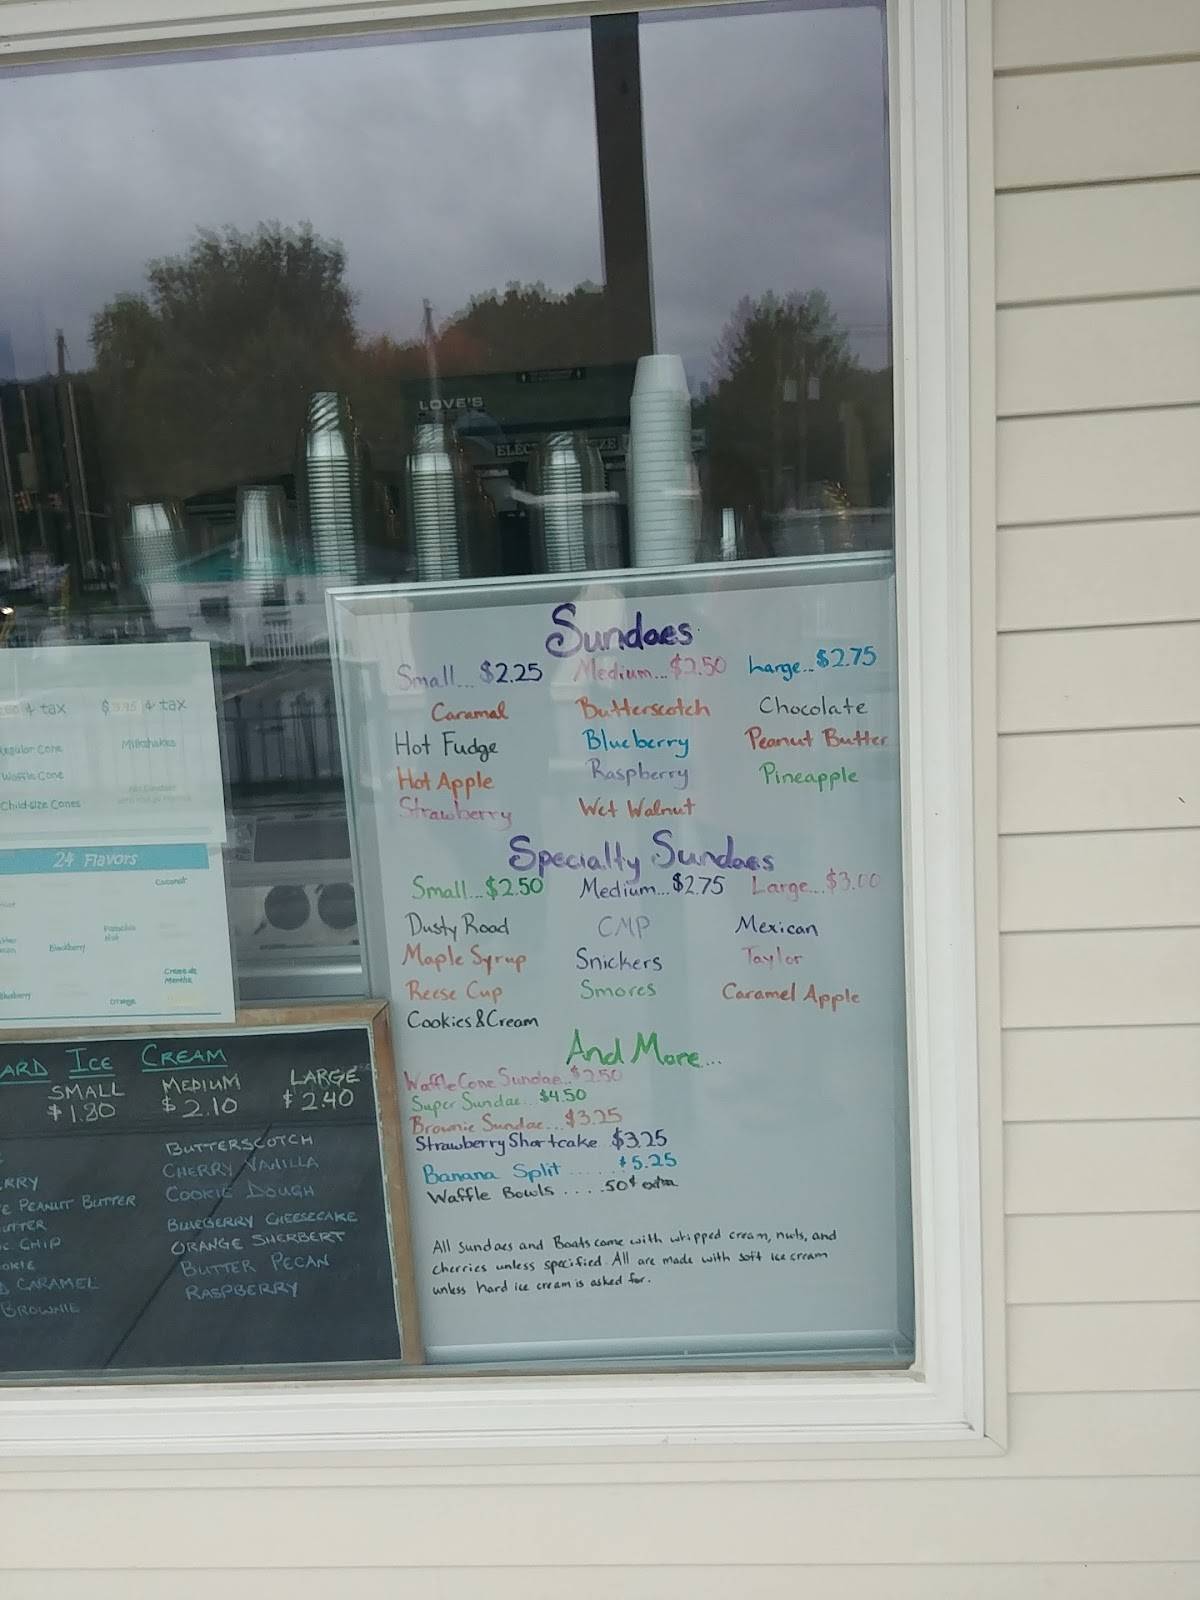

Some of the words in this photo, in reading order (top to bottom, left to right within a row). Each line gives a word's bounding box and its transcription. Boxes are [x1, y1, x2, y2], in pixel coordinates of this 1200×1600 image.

[419, 397, 484, 411] LOVE'S
[546, 602, 693, 657] Sundaes
[480, 660, 543, 684] $2.25
[40, 703, 67, 715] tax
[159, 698, 187, 711] tax
[575, 696, 710, 719] Butterscotch
[759, 695, 868, 716] Chocolate
[395, 730, 430, 755] Hot
[442, 731, 498, 762] Fudge
[582, 729, 689, 758] Blueberry
[744, 726, 813, 750] Peanut
[822, 728, 888, 747] Butter
[397, 766, 430, 790] Hot
[437, 771, 494, 800] Apple
[587, 758, 688, 790] Raspberry
[759, 761, 859, 792] Pineapple
[399, 796, 512, 831] Strawberry
[578, 797, 617, 817] Wet
[628, 797, 695, 817] Walnut
[53, 851, 75, 868] 24
[84, 853, 138, 867] Flavors
[509, 835, 642, 884] Specialty
[652, 829, 774, 871] Sundaes
[486, 875, 543, 900] $2.50
[673, 873, 725, 895] $2.75
[405, 912, 457, 942] Dusty
[461, 913, 510, 935] Road
[598, 915, 650, 938] CMP
[735, 915, 819, 936] Mexican
[402, 943, 464, 972] Maple
[470, 944, 527, 976] Syrup
[576, 947, 662, 972] Snickers
[741, 946, 803, 971] Taylor
[405, 979, 456, 1001] Reese
[467, 980, 503, 1004] Cup
[580, 979, 656, 1000] Smores
[722, 982, 796, 1001] Caramel
[804, 984, 860, 1012] Apple
[566, 1028, 624, 1065] And
[48, 1081, 125, 1100] SMALL
[162, 1073, 240, 1095] MEDIUM
[291, 1066, 360, 1088] LARGE
[403, 1071, 457, 1091] Waffle
[458, 1072, 496, 1089] Cone
[412, 1095, 456, 1118] Super
[409, 1115, 475, 1135] Brownie
[166, 1134, 313, 1156] BUTTERSCOTCH
[416, 1135, 505, 1156] Strawberry
[508, 1132, 597, 1149] Shortcake
[612, 1127, 667, 1150] $3.25
[162, 1162, 233, 1178] CHERRY
[246, 1156, 320, 1172] VANILLA
[422, 1164, 497, 1184] Banana
[512, 1162, 560, 1183] Split
[166, 1183, 232, 1202] COOKIE
[247, 1180, 315, 1198] DOUGH
[427, 1190, 491, 1204] Waffle
[503, 1183, 554, 1199] Bowls
[642, 1176, 679, 1190] extra
[19, 1198, 75, 1212] PEANUT
[81, 1194, 136, 1209] BUTTER
[168, 1215, 254, 1232] BLUEBERRY
[265, 1211, 358, 1225] CHEESECAKE
[19, 1236, 61, 1250] CHIP
[171, 1238, 243, 1255] ORANGE
[252, 1231, 346, 1247] SHERBERT
[433, 1239, 451, 1255] All
[519, 1239, 544, 1250] and
[552, 1235, 591, 1249] Boats
[594, 1237, 624, 1248] come
[630, 1232, 662, 1245] with
[670, 1228, 721, 1245] whipped
[812, 1229, 837, 1241] and
[181, 1260, 256, 1277] BUTTER
[271, 1252, 329, 1271] PECAN
[432, 1262, 487, 1275] cherries
[496, 1260, 535, 1271] unless
[612, 1251, 630, 1266] All
[638, 1257, 656, 1266] are
[662, 1254, 694, 1265] made
[702, 1251, 730, 1263] with
[738, 1251, 762, 1262] soft
[17, 1276, 98, 1291] CARAMEL
[185, 1282, 298, 1300] RASPBERRY
[433, 1284, 466, 1296] unless
[477, 1280, 508, 1294] hard
[515, 1282, 529, 1292] ice
[537, 1280, 571, 1291] cream
[576, 1279, 584, 1289] is
[590, 1275, 622, 1287] asked
